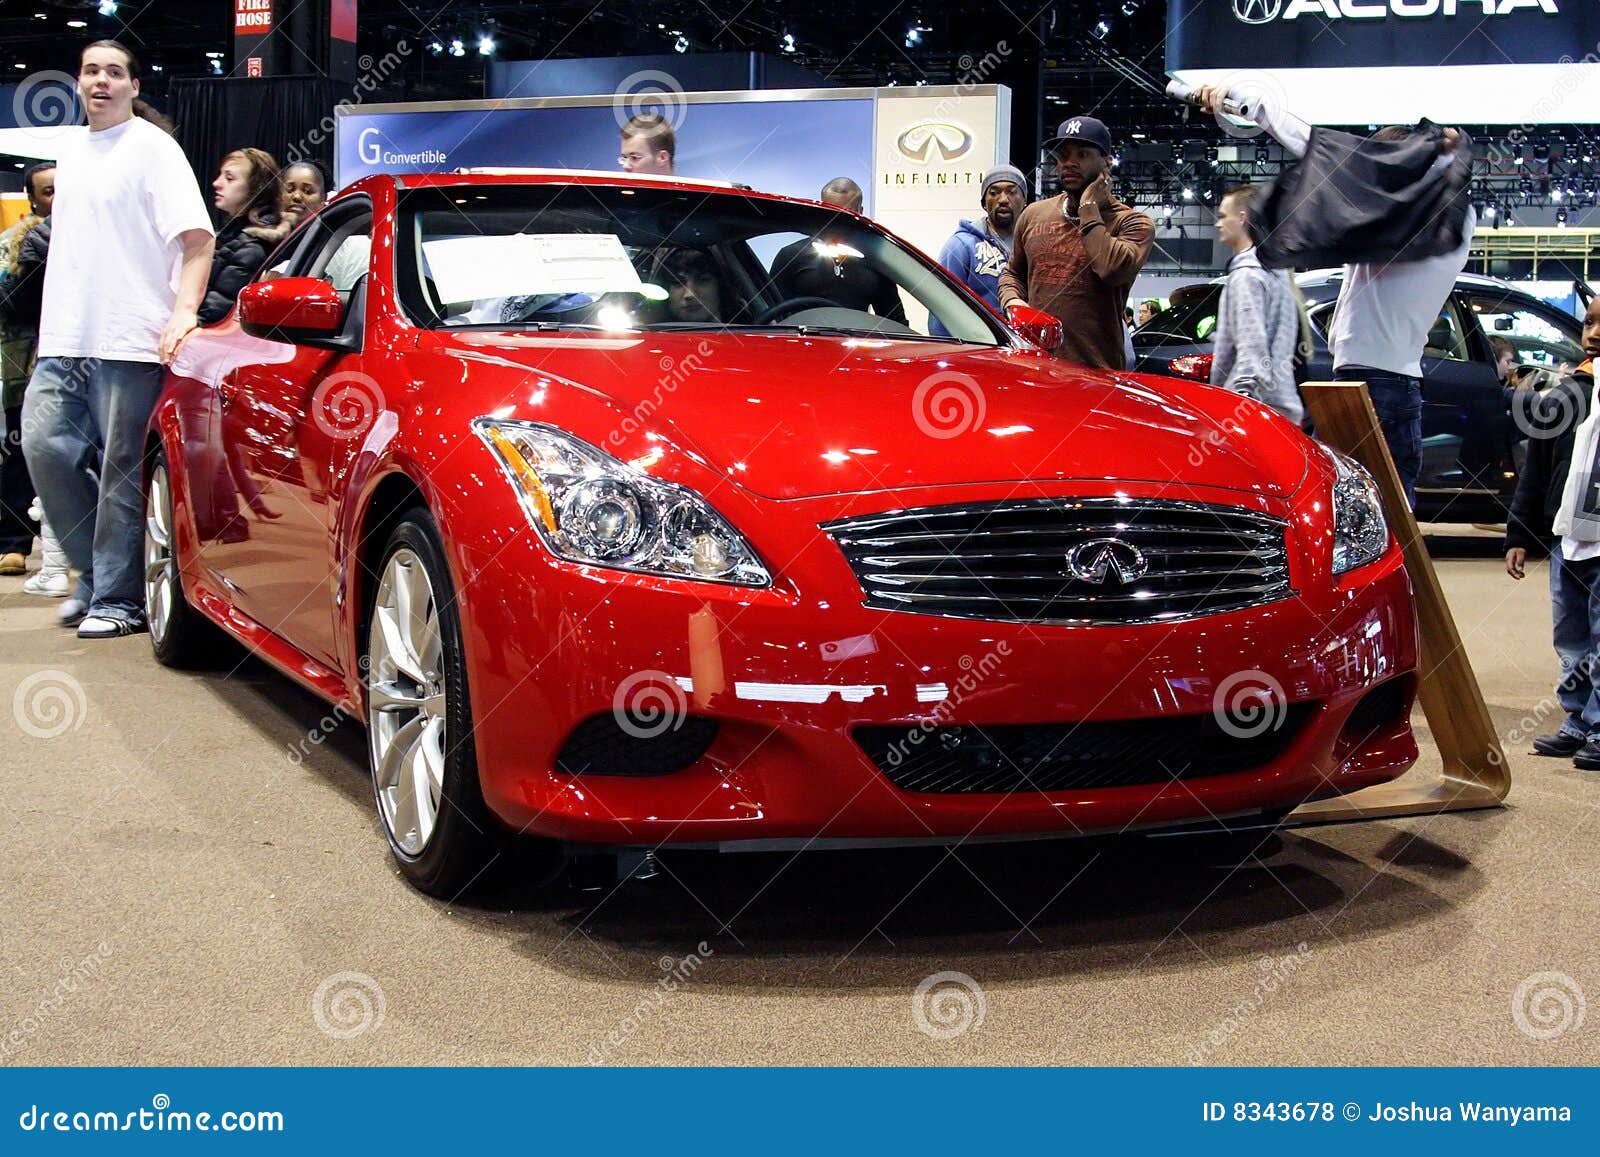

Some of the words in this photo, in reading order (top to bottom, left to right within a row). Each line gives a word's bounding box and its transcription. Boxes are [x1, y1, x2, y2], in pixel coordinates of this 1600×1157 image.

[237, 0, 270, 10] FIRE
[235, 12, 272, 26] HOSE
[358, 127, 381, 165] G
[383, 149, 447, 164] Convertible
[884, 172, 984, 185] INFINITI
